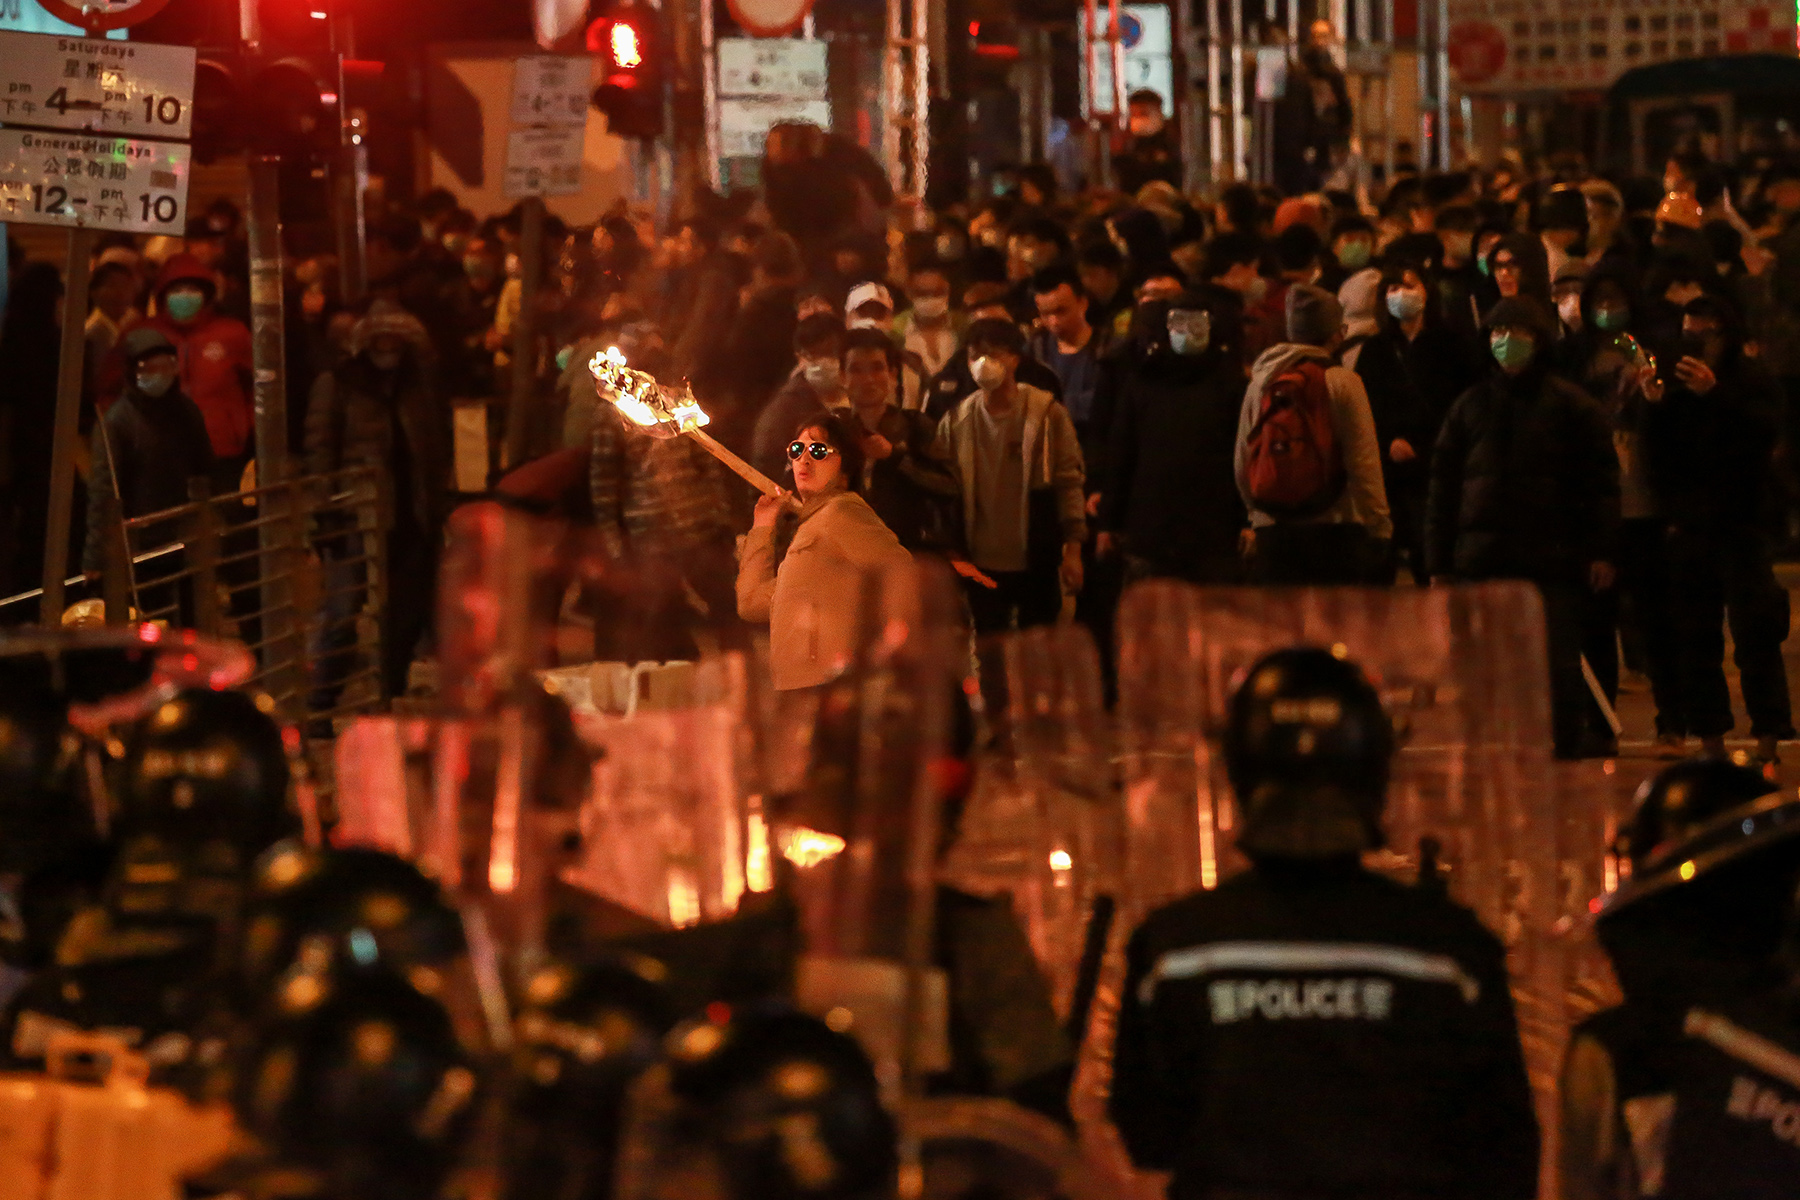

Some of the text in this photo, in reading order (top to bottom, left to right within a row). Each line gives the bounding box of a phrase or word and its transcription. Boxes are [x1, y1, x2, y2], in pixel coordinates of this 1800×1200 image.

[58, 39, 135, 59] Saturdays
[64, 58, 125, 82] 星期六
[3, 98, 133, 125] 下午 下午
[9, 82, 32, 94] pm
[105, 91, 128, 102] pm
[143, 94, 181, 124] 10
[22, 134, 151, 158] General Holidays
[94, 205, 129, 221] 下午
[101, 188, 124, 200] pm
[140, 193, 178, 223] 10
